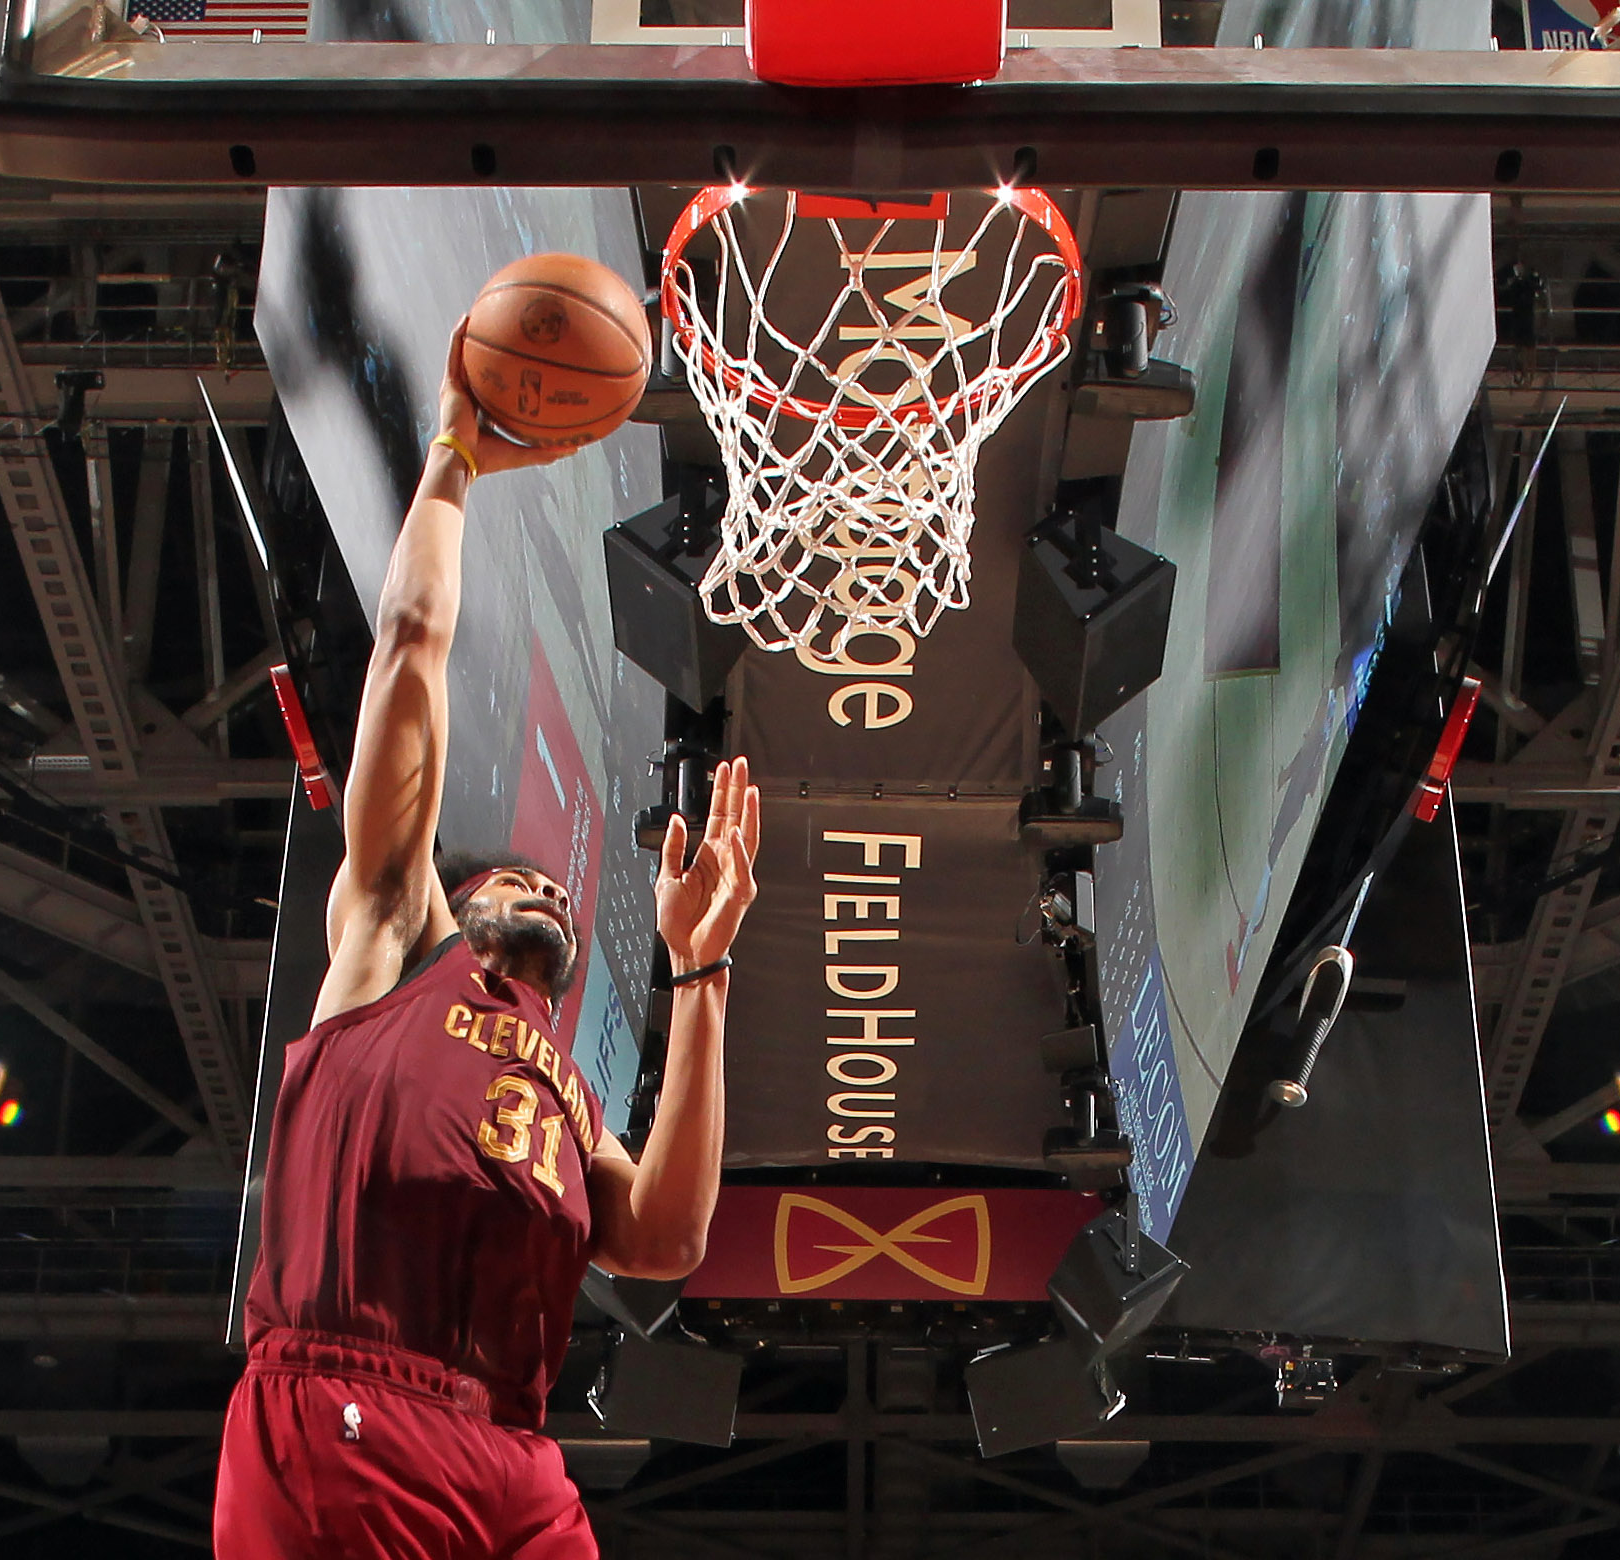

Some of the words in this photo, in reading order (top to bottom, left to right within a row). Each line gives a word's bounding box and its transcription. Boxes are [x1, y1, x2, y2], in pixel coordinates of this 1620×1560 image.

[1541, 30, 1590, 51] NBA
[443, 1004, 595, 1153] CLEVELAND
[476, 1074, 566, 1198] 31
